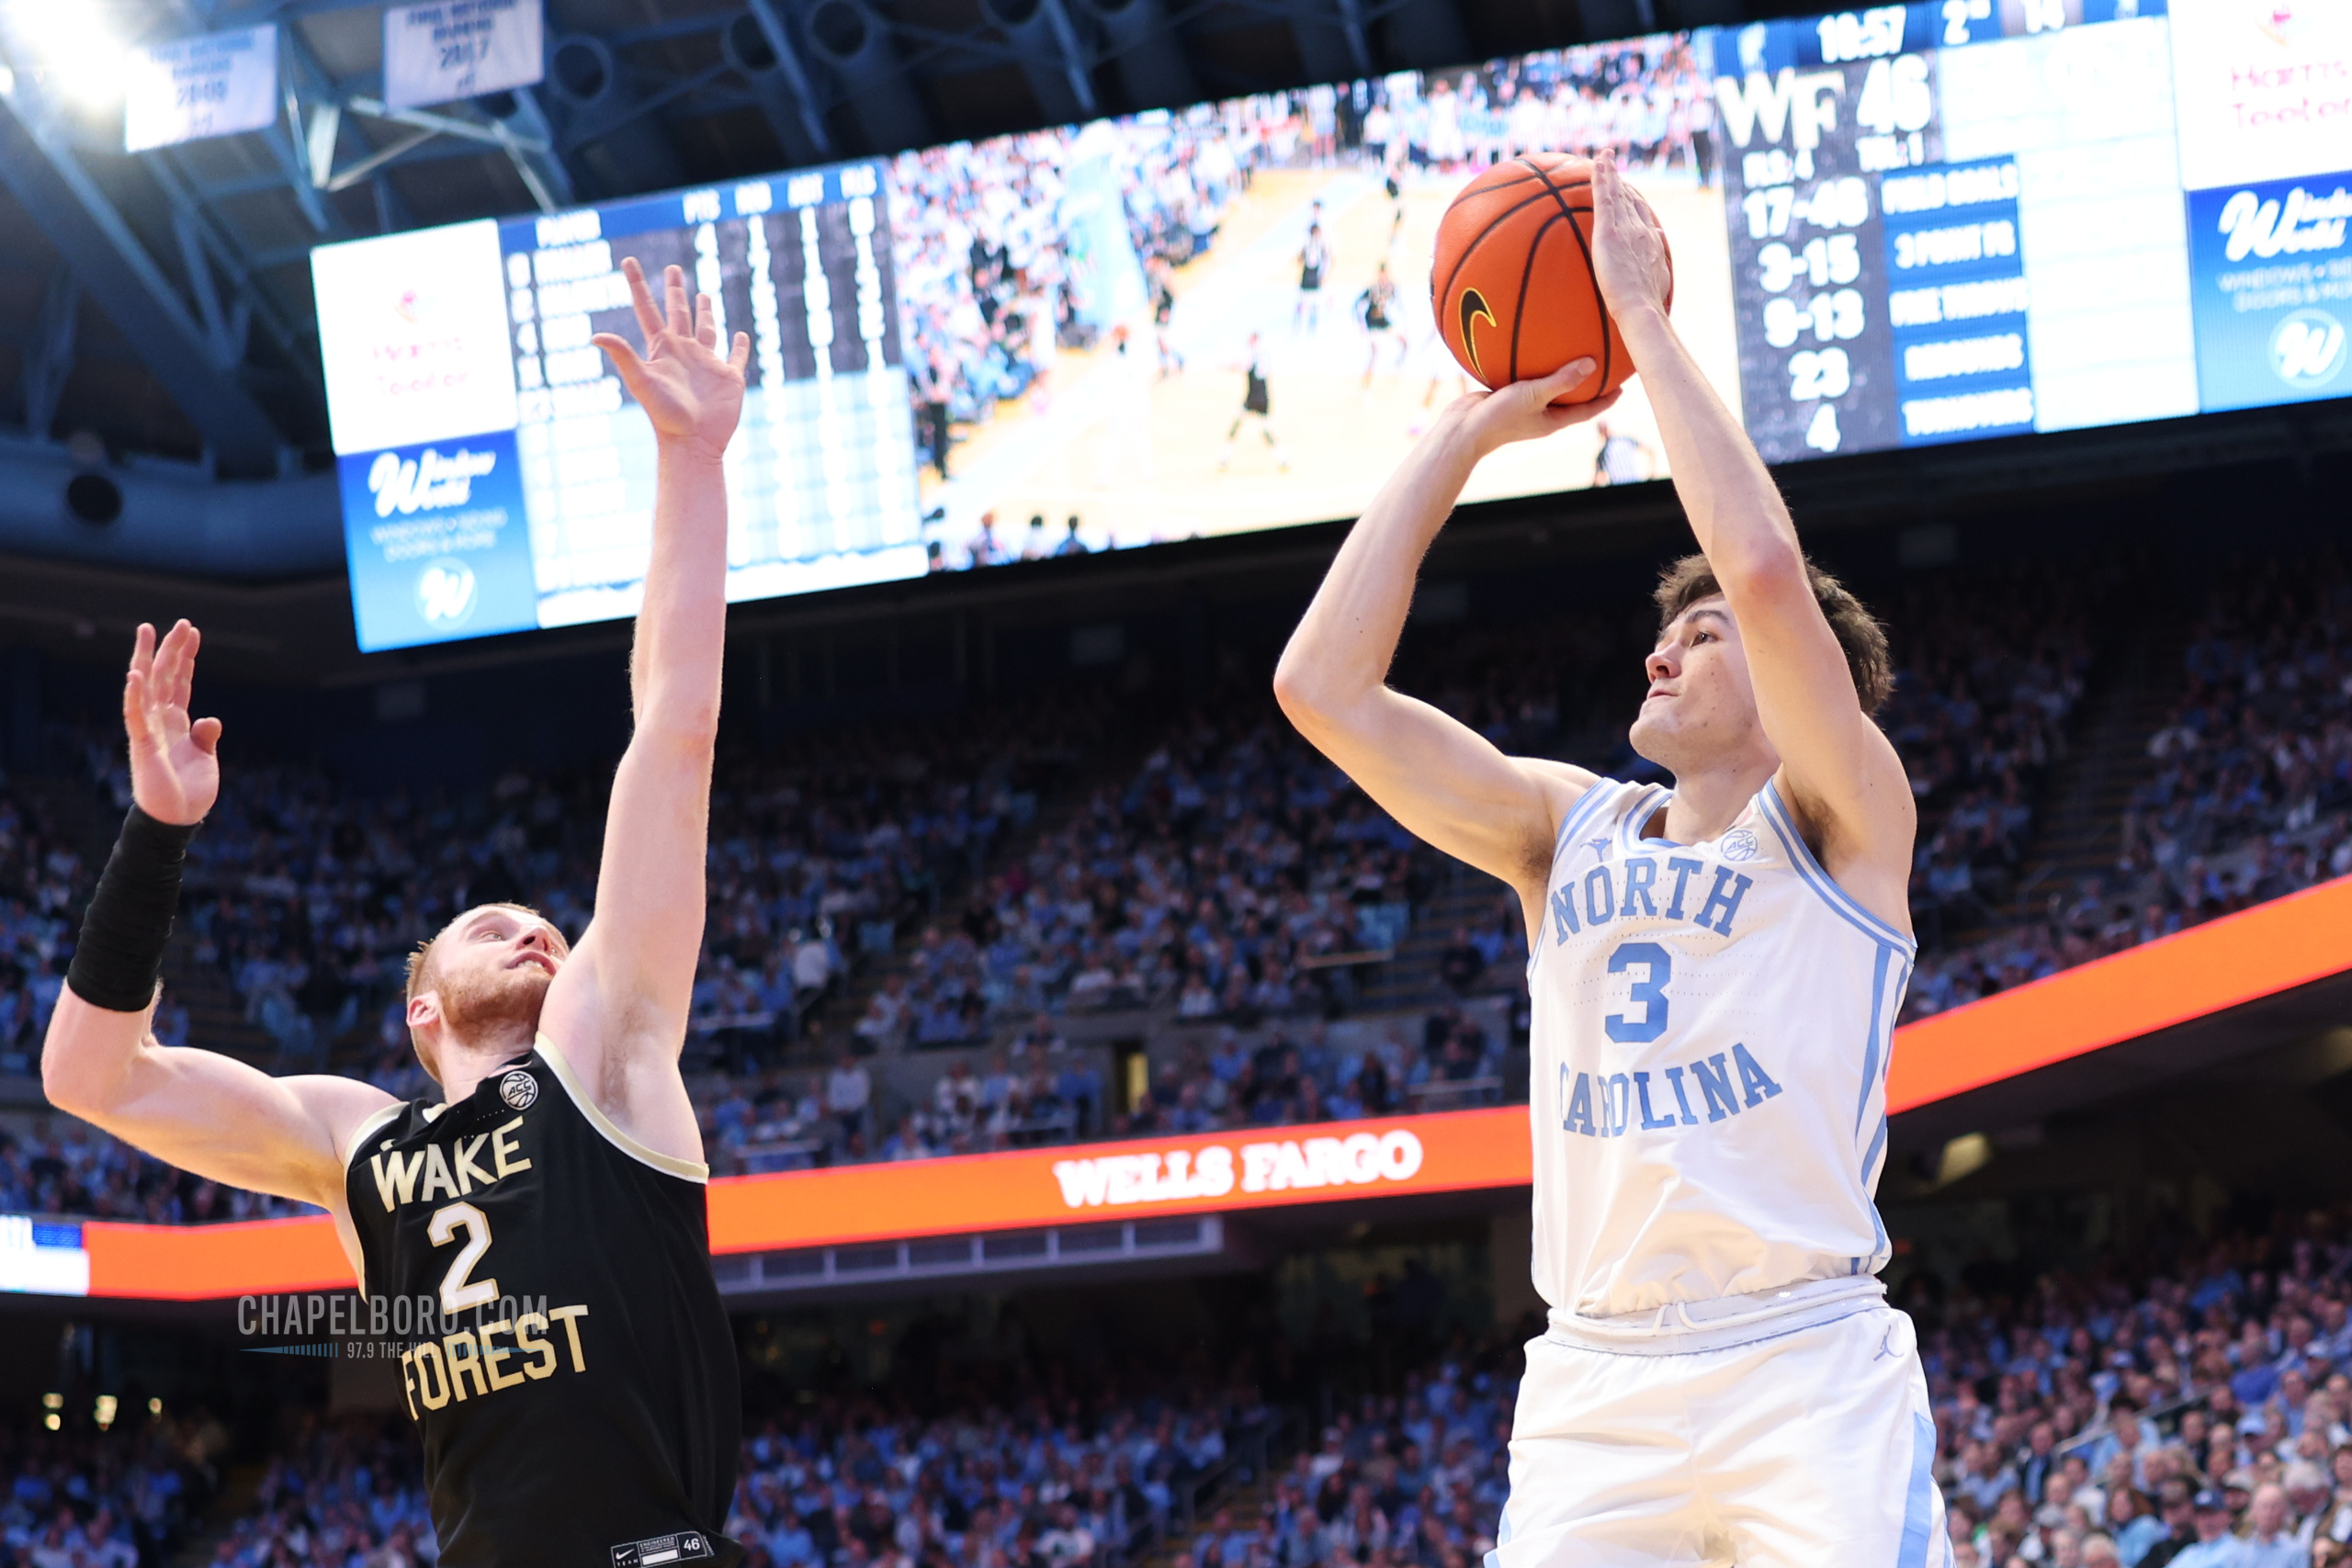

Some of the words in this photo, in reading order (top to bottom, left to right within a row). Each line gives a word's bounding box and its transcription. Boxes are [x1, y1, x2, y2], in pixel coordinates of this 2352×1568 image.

[1713, 68, 1846, 148] WF
[1857, 53, 1930, 134] 46
[1758, 232, 1860, 293] 3-15
[1805, 403, 1841, 452] 4
[1551, 857, 1753, 947] NORTH
[1605, 942, 1671, 1043] 3
[370, 1115, 532, 1213] WAKE
[1054, 1146, 1235, 1208] WELLS
[1240, 1129, 1423, 1192] FARGO
[426, 1201, 500, 1314] 2
[401, 1304, 589, 1421] FOREST
[684, 1538, 701, 1551] 46
